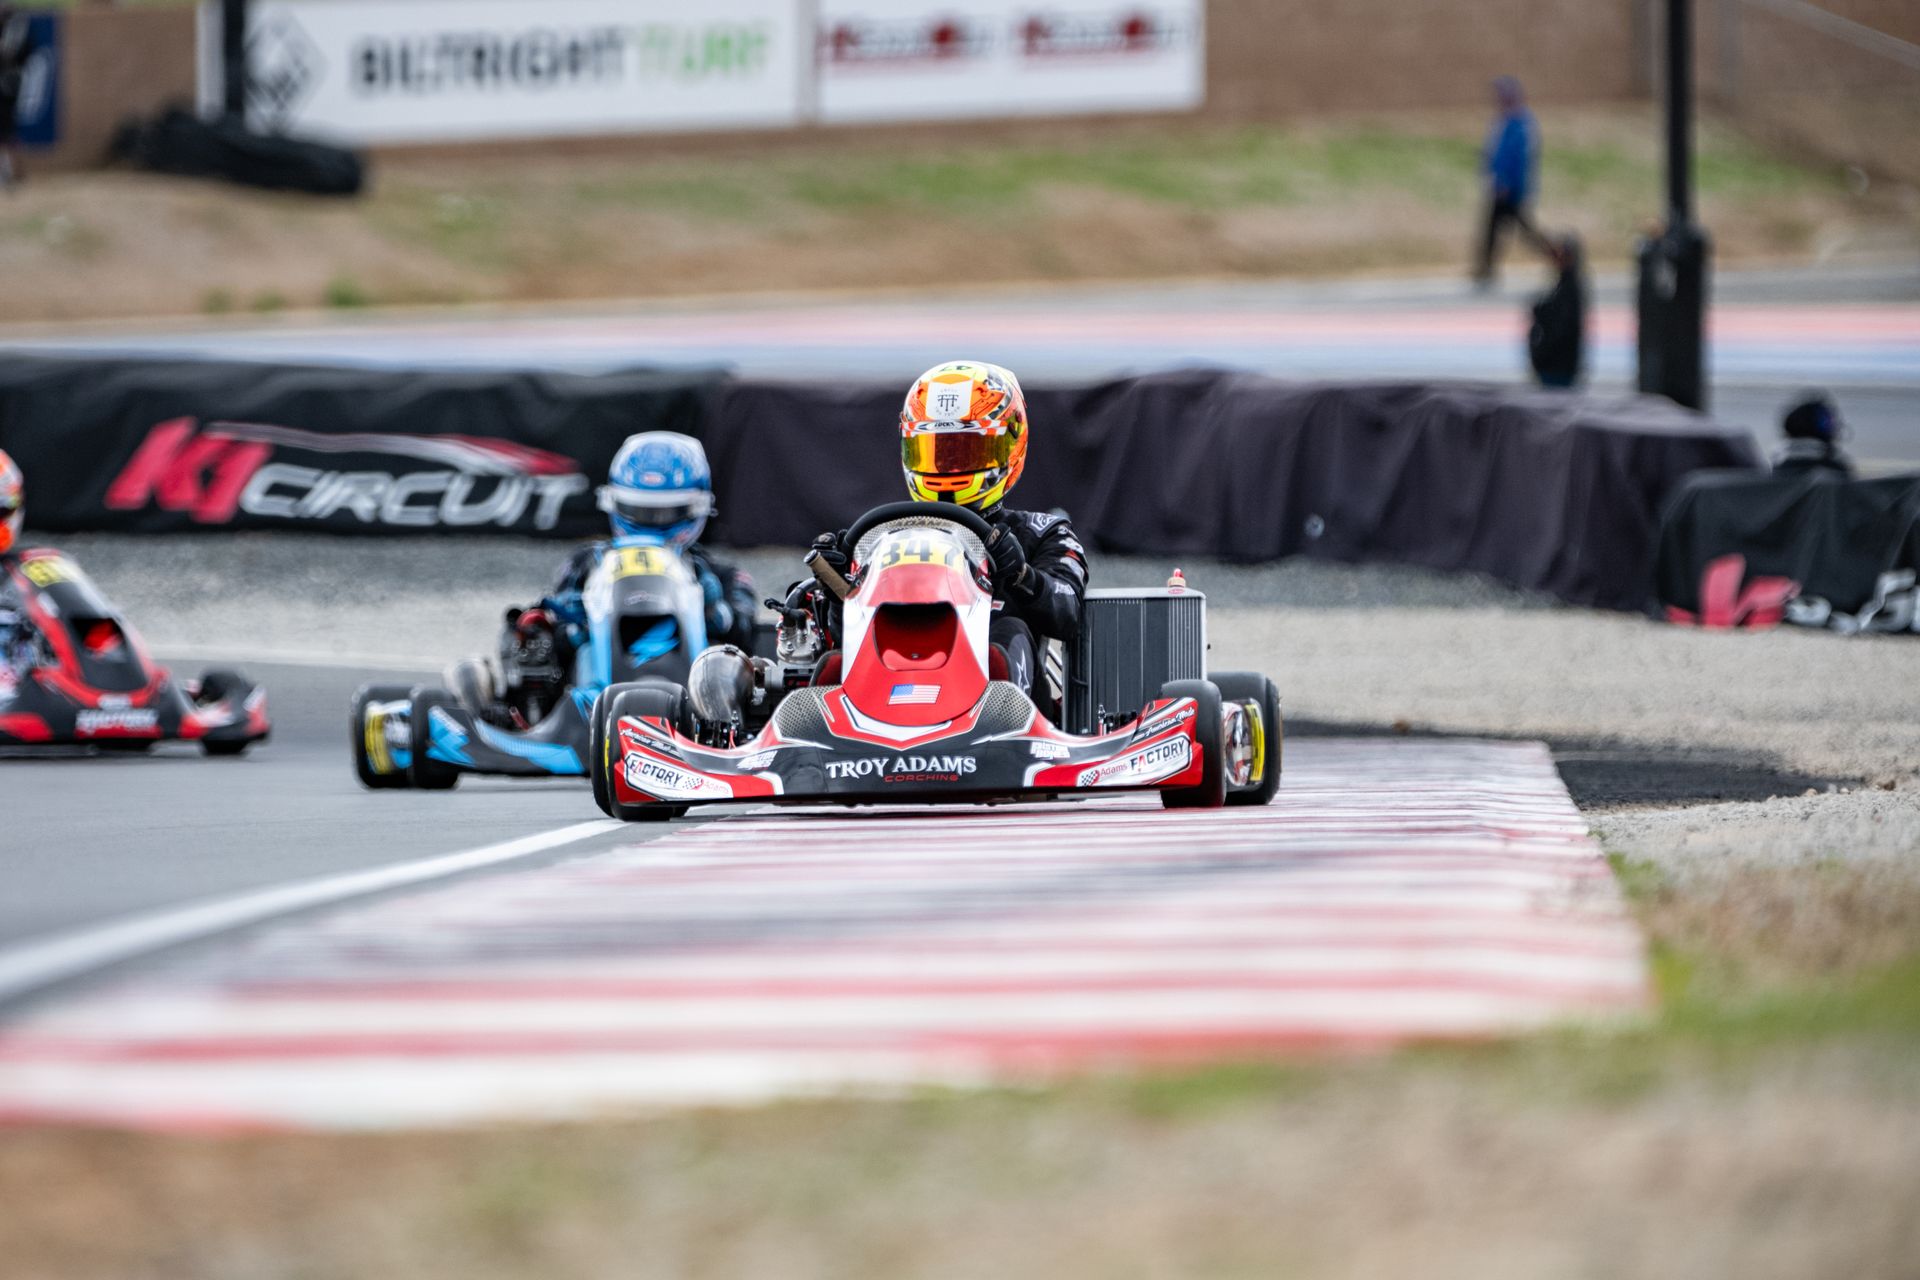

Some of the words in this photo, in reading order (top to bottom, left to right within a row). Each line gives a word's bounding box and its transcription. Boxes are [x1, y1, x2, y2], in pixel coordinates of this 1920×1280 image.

[240, 463, 589, 530] CIRCUIT
[629, 759, 684, 785] FACTORY
[825, 758, 890, 779] TROY
[891, 755, 978, 776] ADAMS
[1100, 763, 1128, 776] Adams
[1130, 739, 1185, 771] FACTORY
